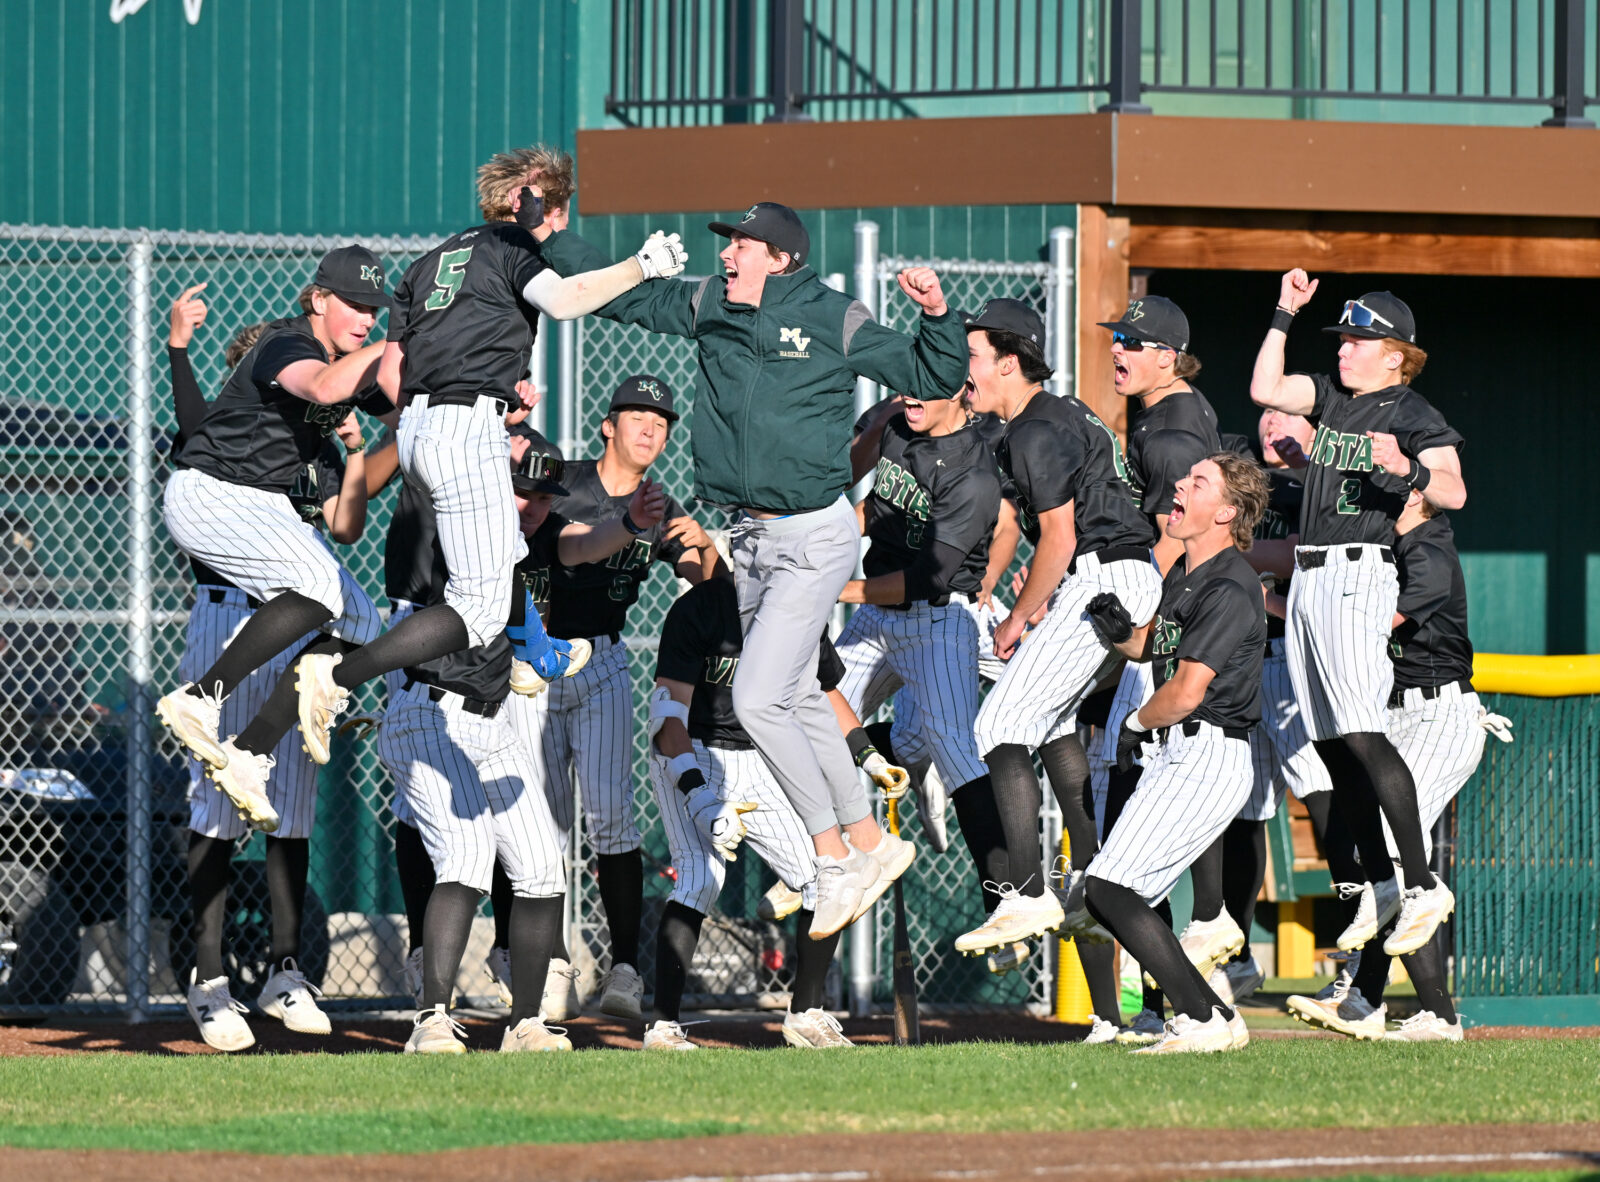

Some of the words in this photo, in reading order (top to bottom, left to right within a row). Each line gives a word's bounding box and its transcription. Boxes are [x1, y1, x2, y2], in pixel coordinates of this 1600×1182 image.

[361, 265, 383, 289] MV
[424, 245, 474, 311] 5
[779, 327, 811, 351] MV
[637, 380, 664, 401] MV
[1336, 479, 1361, 515] 2
